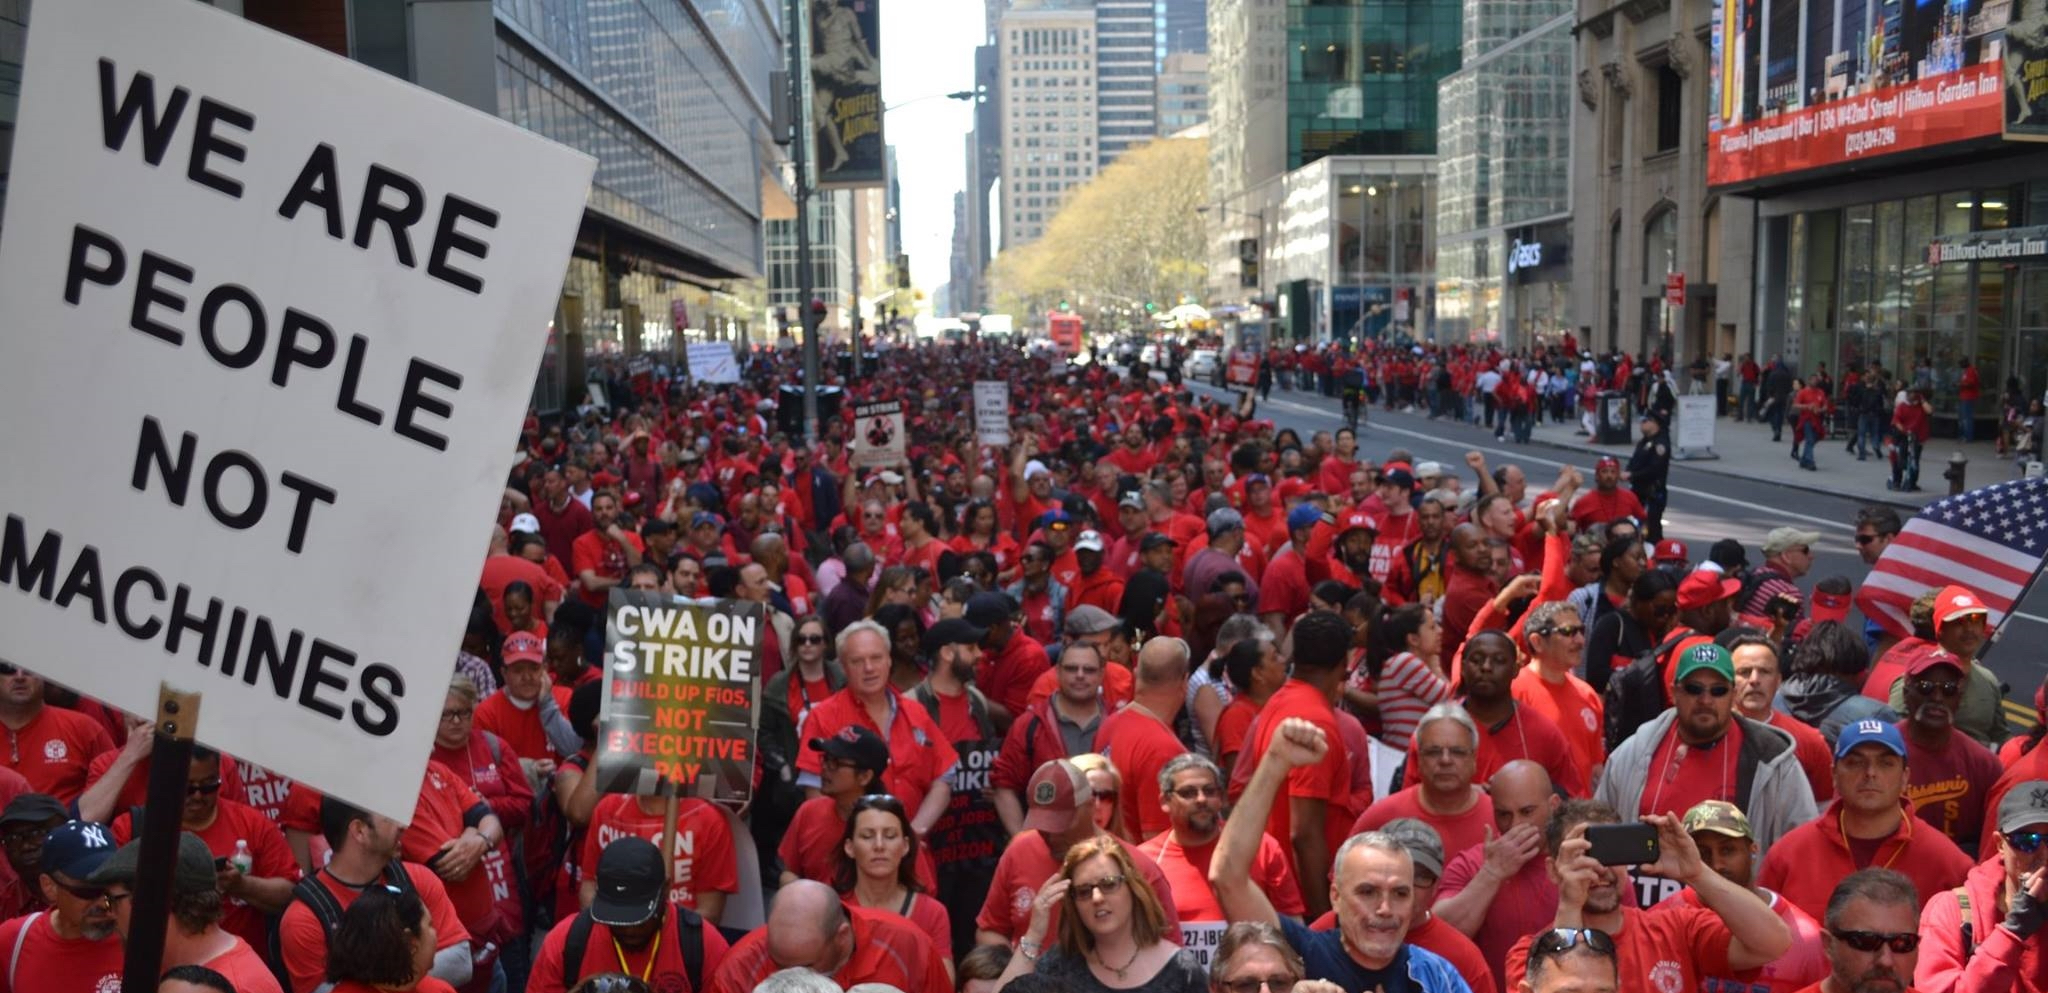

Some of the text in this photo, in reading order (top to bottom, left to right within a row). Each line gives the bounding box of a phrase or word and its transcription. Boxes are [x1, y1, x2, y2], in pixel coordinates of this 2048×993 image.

[1799, 114, 1815, 137] Bar
[1870, 91, 1899, 120] Street
[1904, 84, 1936, 113] Hilton
[1936, 73, 1977, 106] Garden
[1978, 71, 1999, 97] Inn
[98, 56, 501, 296] WE ARE
[1940, 238, 2046, 262] Hilton Garden Inn
[64, 223, 465, 452] PEOPLE
[855, 401, 900, 415] ON STRIKE
[131, 414, 337, 555] NOT
[0, 513, 406, 738] MACHINES
[615, 604, 756, 647] CWA ON
[613, 639, 753, 683] STRIKE
[612, 679, 670, 700] BUILD
[674, 685, 700, 702] UP
[655, 707, 707, 731] NOT
[607, 730, 748, 761] EXECUTIVE
[655, 761, 702, 784] PAY
[1907, 775, 1969, 800] issouri
